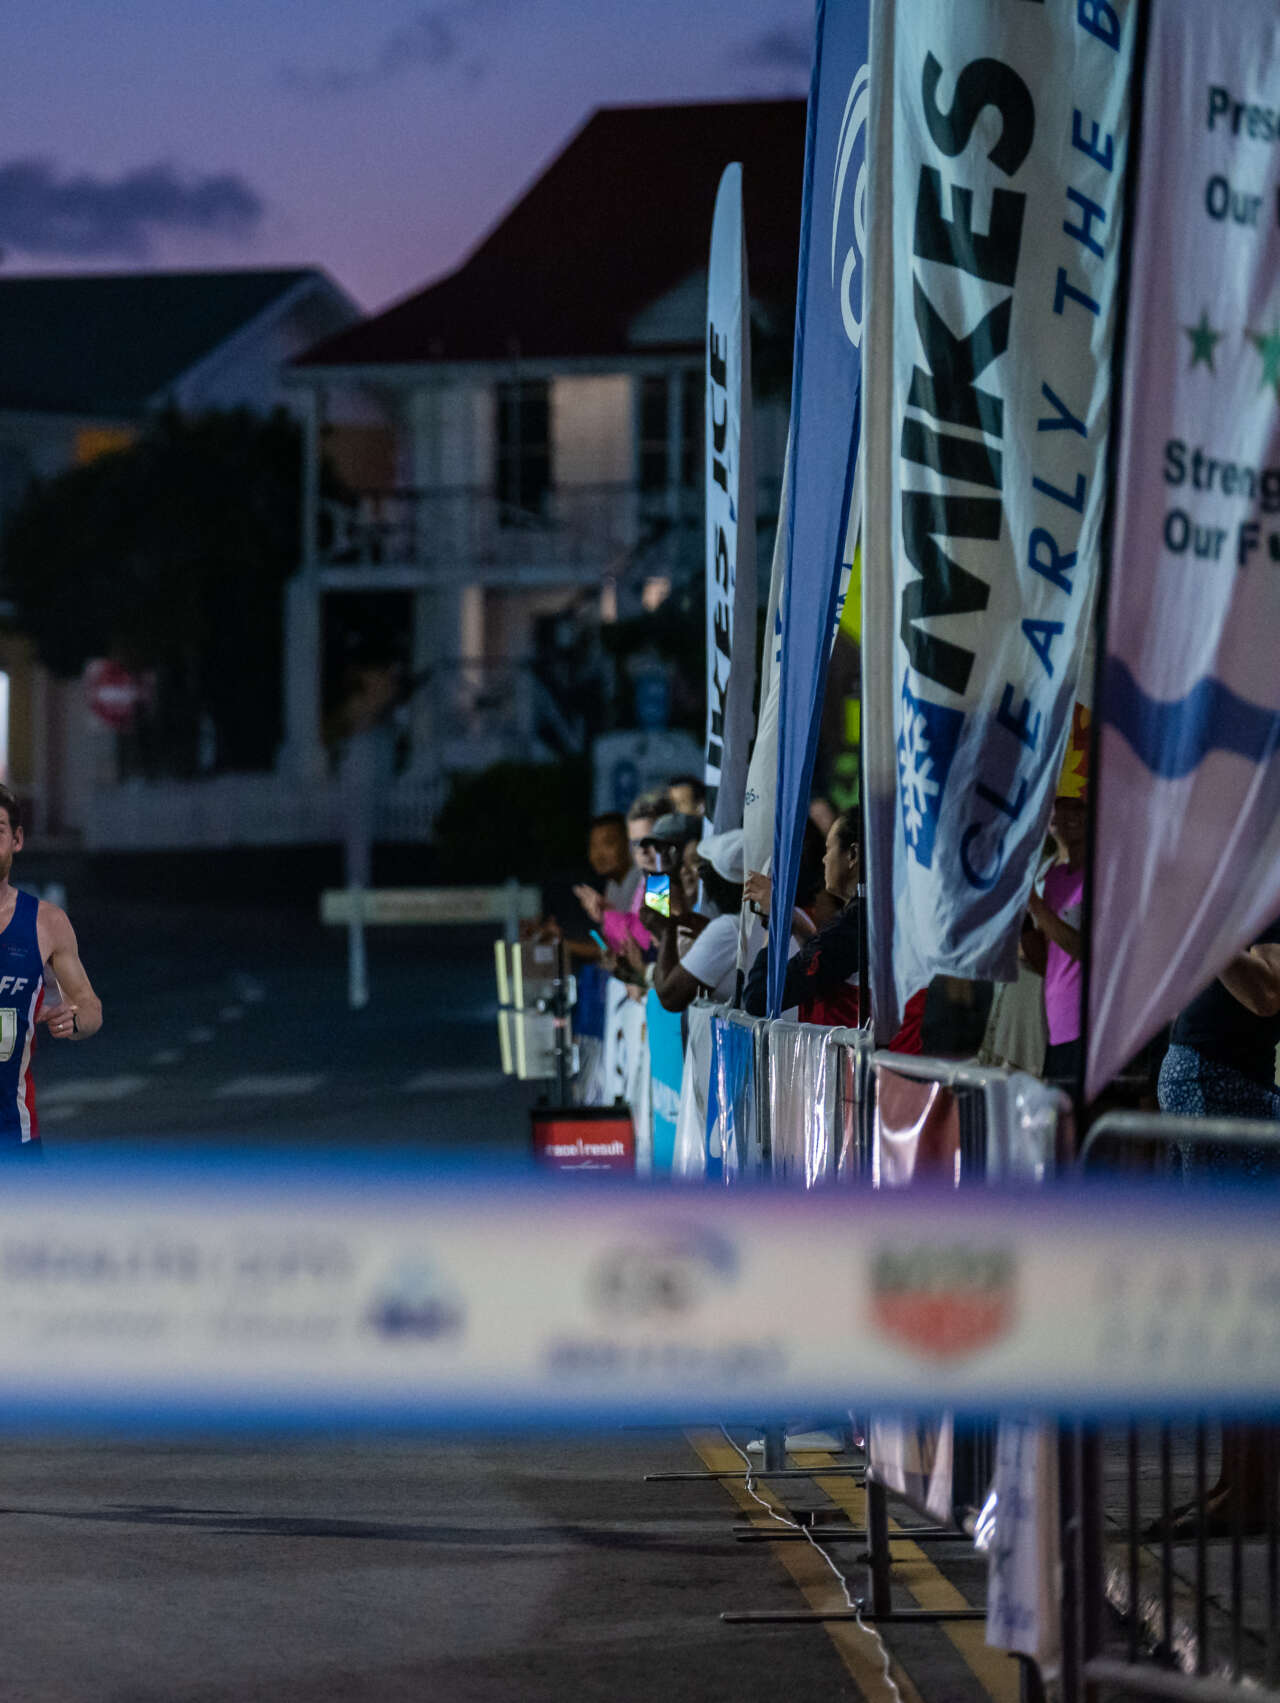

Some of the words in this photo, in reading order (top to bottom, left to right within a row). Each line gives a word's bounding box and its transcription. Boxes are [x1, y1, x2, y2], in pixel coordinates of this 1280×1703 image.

[1208, 86, 1280, 141] Pres
[1206, 175, 1263, 227] Our
[710, 322, 728, 494] ICE
[900, 50, 1035, 695] MIKES
[960, 382, 1088, 889] CLEARLY
[1053, 109, 1114, 316] THE
[1165, 509, 1227, 562] Our
